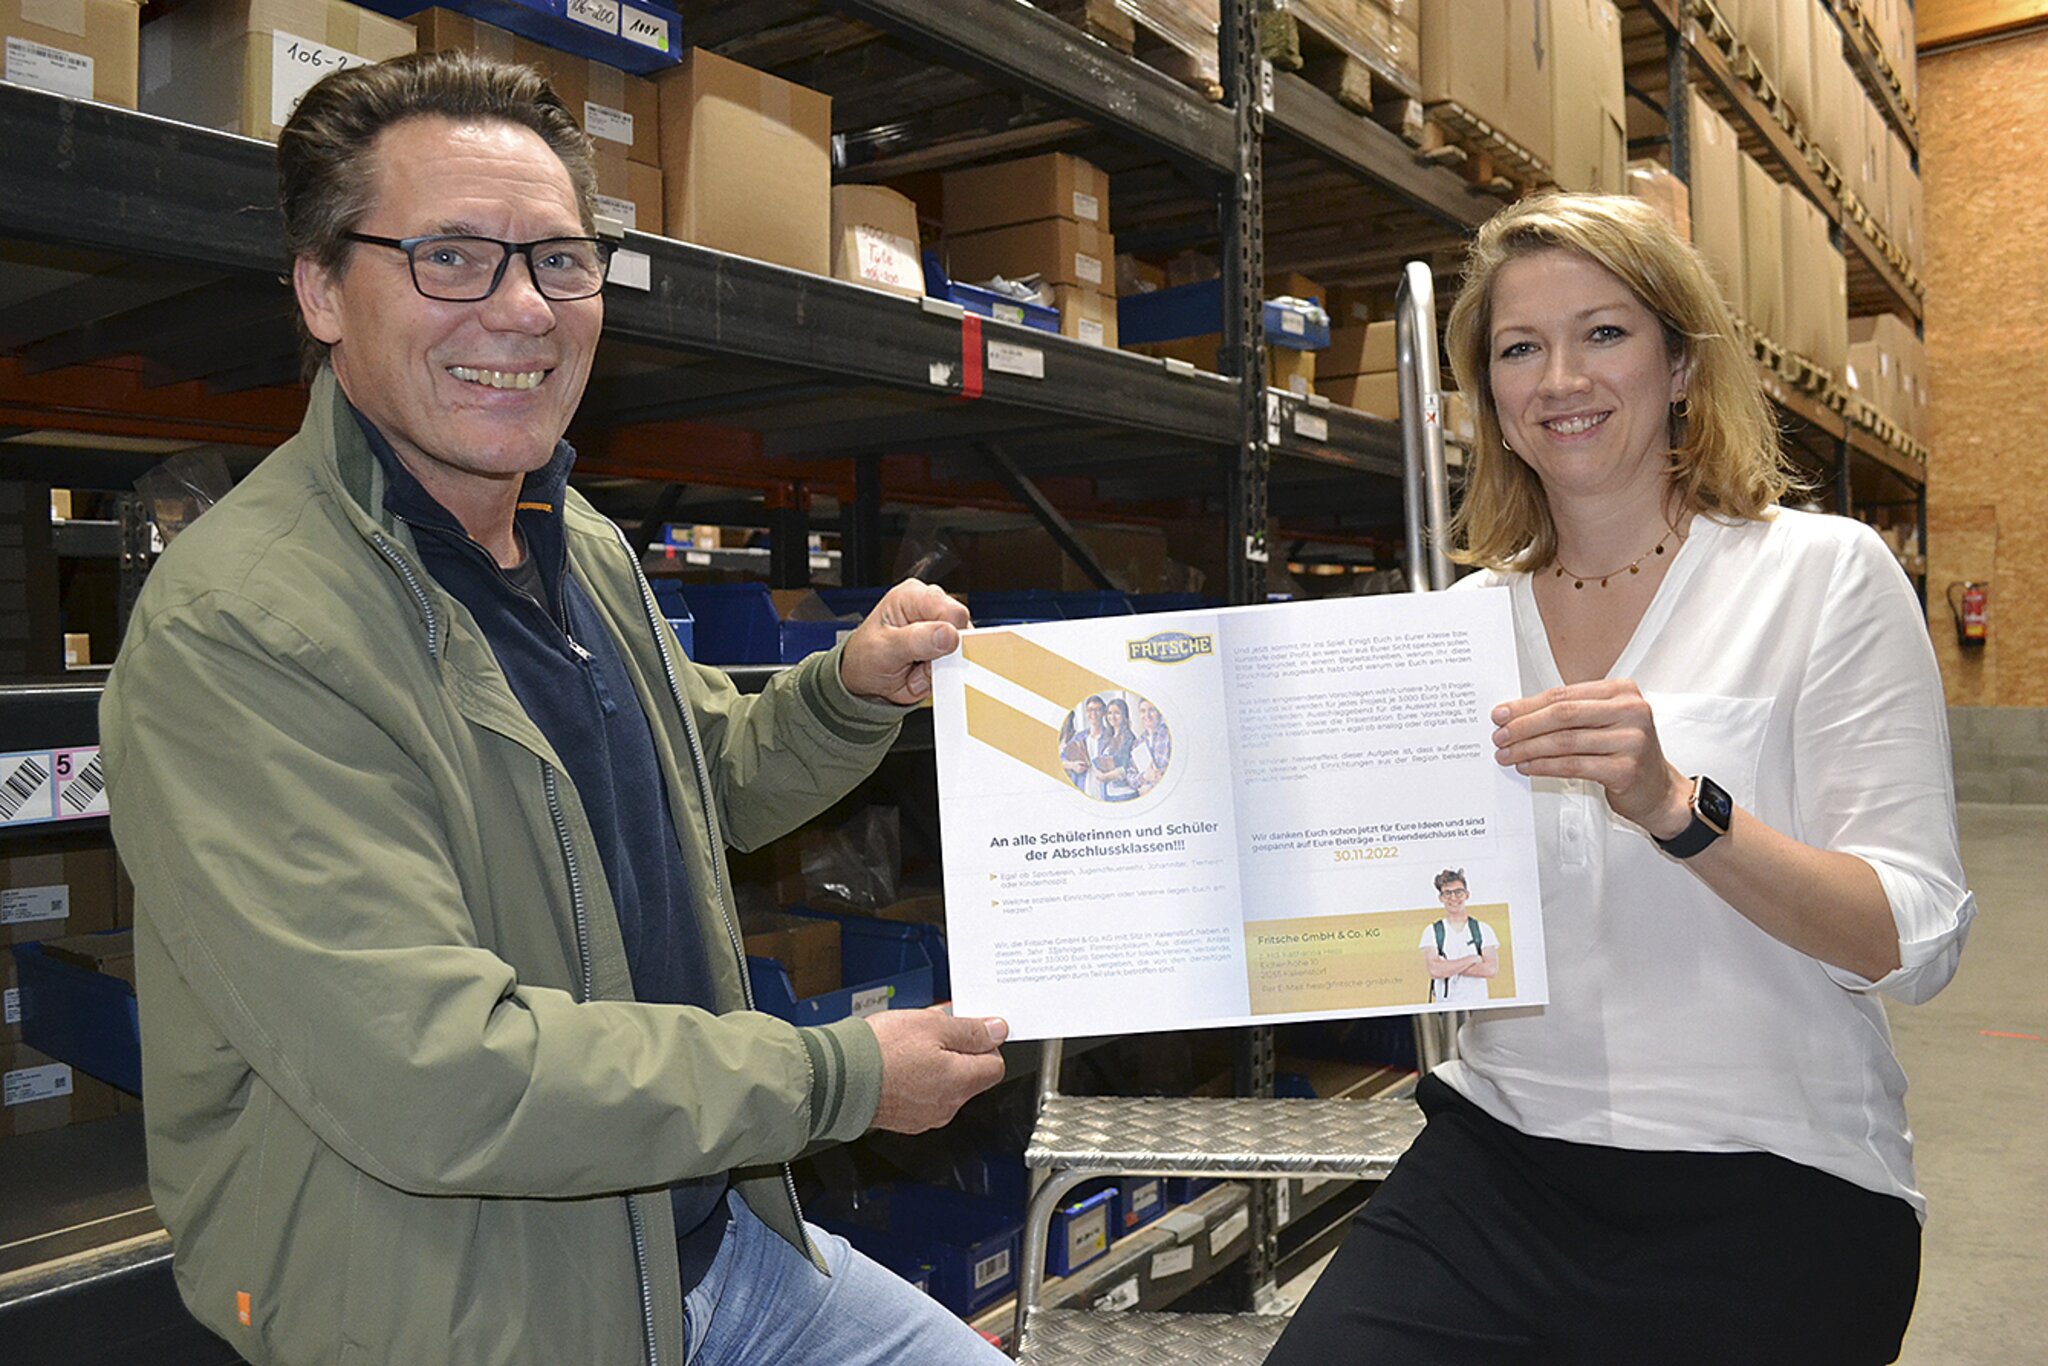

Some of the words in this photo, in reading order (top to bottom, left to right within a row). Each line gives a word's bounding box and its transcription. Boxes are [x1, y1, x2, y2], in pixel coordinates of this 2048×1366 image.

[1264, 71, 1273, 97] 5
[1130, 637, 1212, 658] FRITSCHE
[1372, 635, 1392, 644] Euch
[1407, 658, 1427, 667] Euch
[57, 754, 71, 775] 5
[990, 837, 1008, 848] An
[1012, 834, 1037, 847] alle
[1040, 828, 1132, 845] Schülerinnen
[1136, 825, 1162, 838] und
[1166, 821, 1219, 837] Schüler
[1250, 833, 1267, 842] Wir
[1268, 830, 1303, 841] danken
[1304, 828, 1328, 838] Euch
[1329, 826, 1356, 836] schon
[1358, 824, 1378, 836] jetzt
[1380, 823, 1392, 832] für
[1394, 821, 1416, 831] Eure
[1418, 819, 1443, 830] Ideen
[1445, 818, 1463, 827] und
[1465, 816, 1484, 826] sind
[1025, 849, 1048, 861] der
[1052, 839, 1186, 859] Abschlussklassen!!!
[1251, 841, 1294, 855] gespannt
[1296, 839, 1311, 849] auf
[1312, 838, 1333, 848] Eure
[1335, 835, 1374, 848] Beiträge
[1382, 828, 1456, 842] Einsendeschluss
[1458, 827, 1468, 837] ist
[1470, 826, 1485, 836] der
[1334, 847, 1399, 862] 30.11.2022
[1258, 934, 1300, 945] Fritsche
[1302, 931, 1335, 942] GmbH
[1338, 931, 1346, 940] &
[1346, 930, 1364, 940] Co.
[1366, 928, 1381, 938] KG
